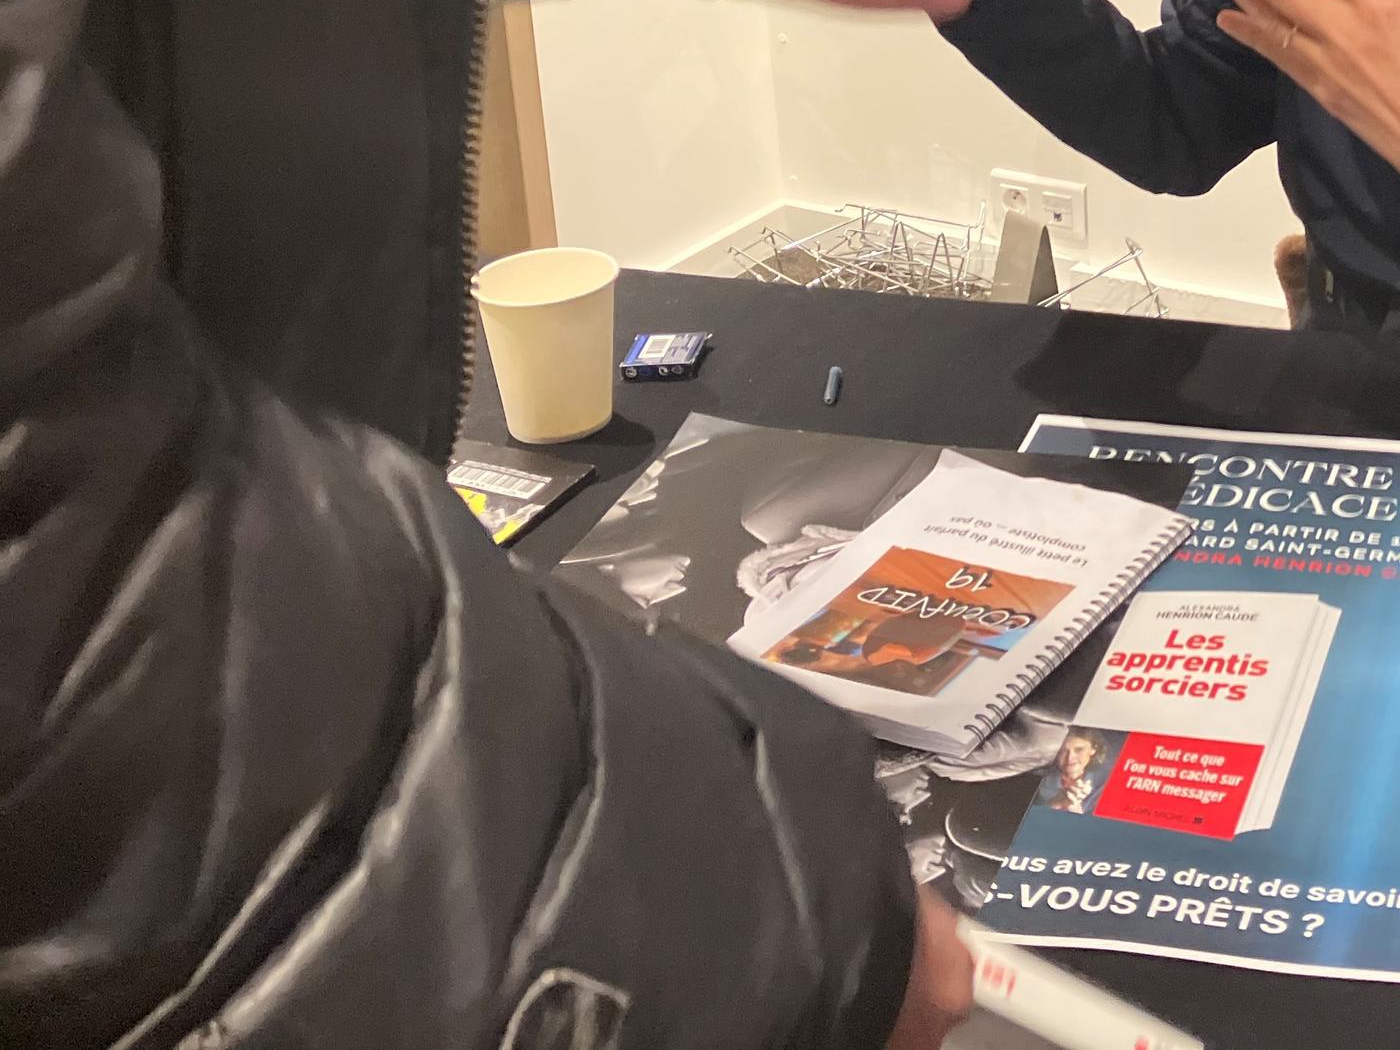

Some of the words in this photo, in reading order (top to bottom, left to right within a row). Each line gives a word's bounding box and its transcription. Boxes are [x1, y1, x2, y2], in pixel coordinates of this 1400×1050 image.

[924, 525, 969, 542] parfait
[971, 531, 988, 543] du
[1008, 527, 1087, 552] complotiste
[1249, 522, 1340, 542] PARTIR
[1349, 531, 1382, 545] DE
[988, 538, 1037, 560] illustré
[1038, 549, 1068, 566] petit
[1072, 556, 1088, 568] Le
[1253, 555, 1373, 578] HENRION
[945, 566, 992, 592] 19
[1156, 611, 1212, 621] HENRION
[1215, 612, 1260, 622] CAUDE
[1179, 604, 1240, 612] ALEXANDRA
[1164, 629, 1226, 651] Les
[1106, 652, 1270, 677] apprentis
[1105, 675, 1249, 701] sorciers
[1154, 746, 1182, 762] Tout
[1183, 753, 1199, 764] ce
[1200, 754, 1225, 768] que
[1148, 765, 1177, 778] vous
[1179, 769, 1218, 785] cache
[1220, 774, 1244, 787] sur
[1126, 776, 1162, 793] l'ARN
[1161, 784, 1227, 804] messager
[1053, 859, 1131, 879] avez
[1136, 862, 1167, 882] le
[1173, 867, 1252, 894] droit
[1258, 878, 1300, 899] de
[1146, 895, 1290, 935] PRÊTS
[1302, 913, 1325, 938] ?
